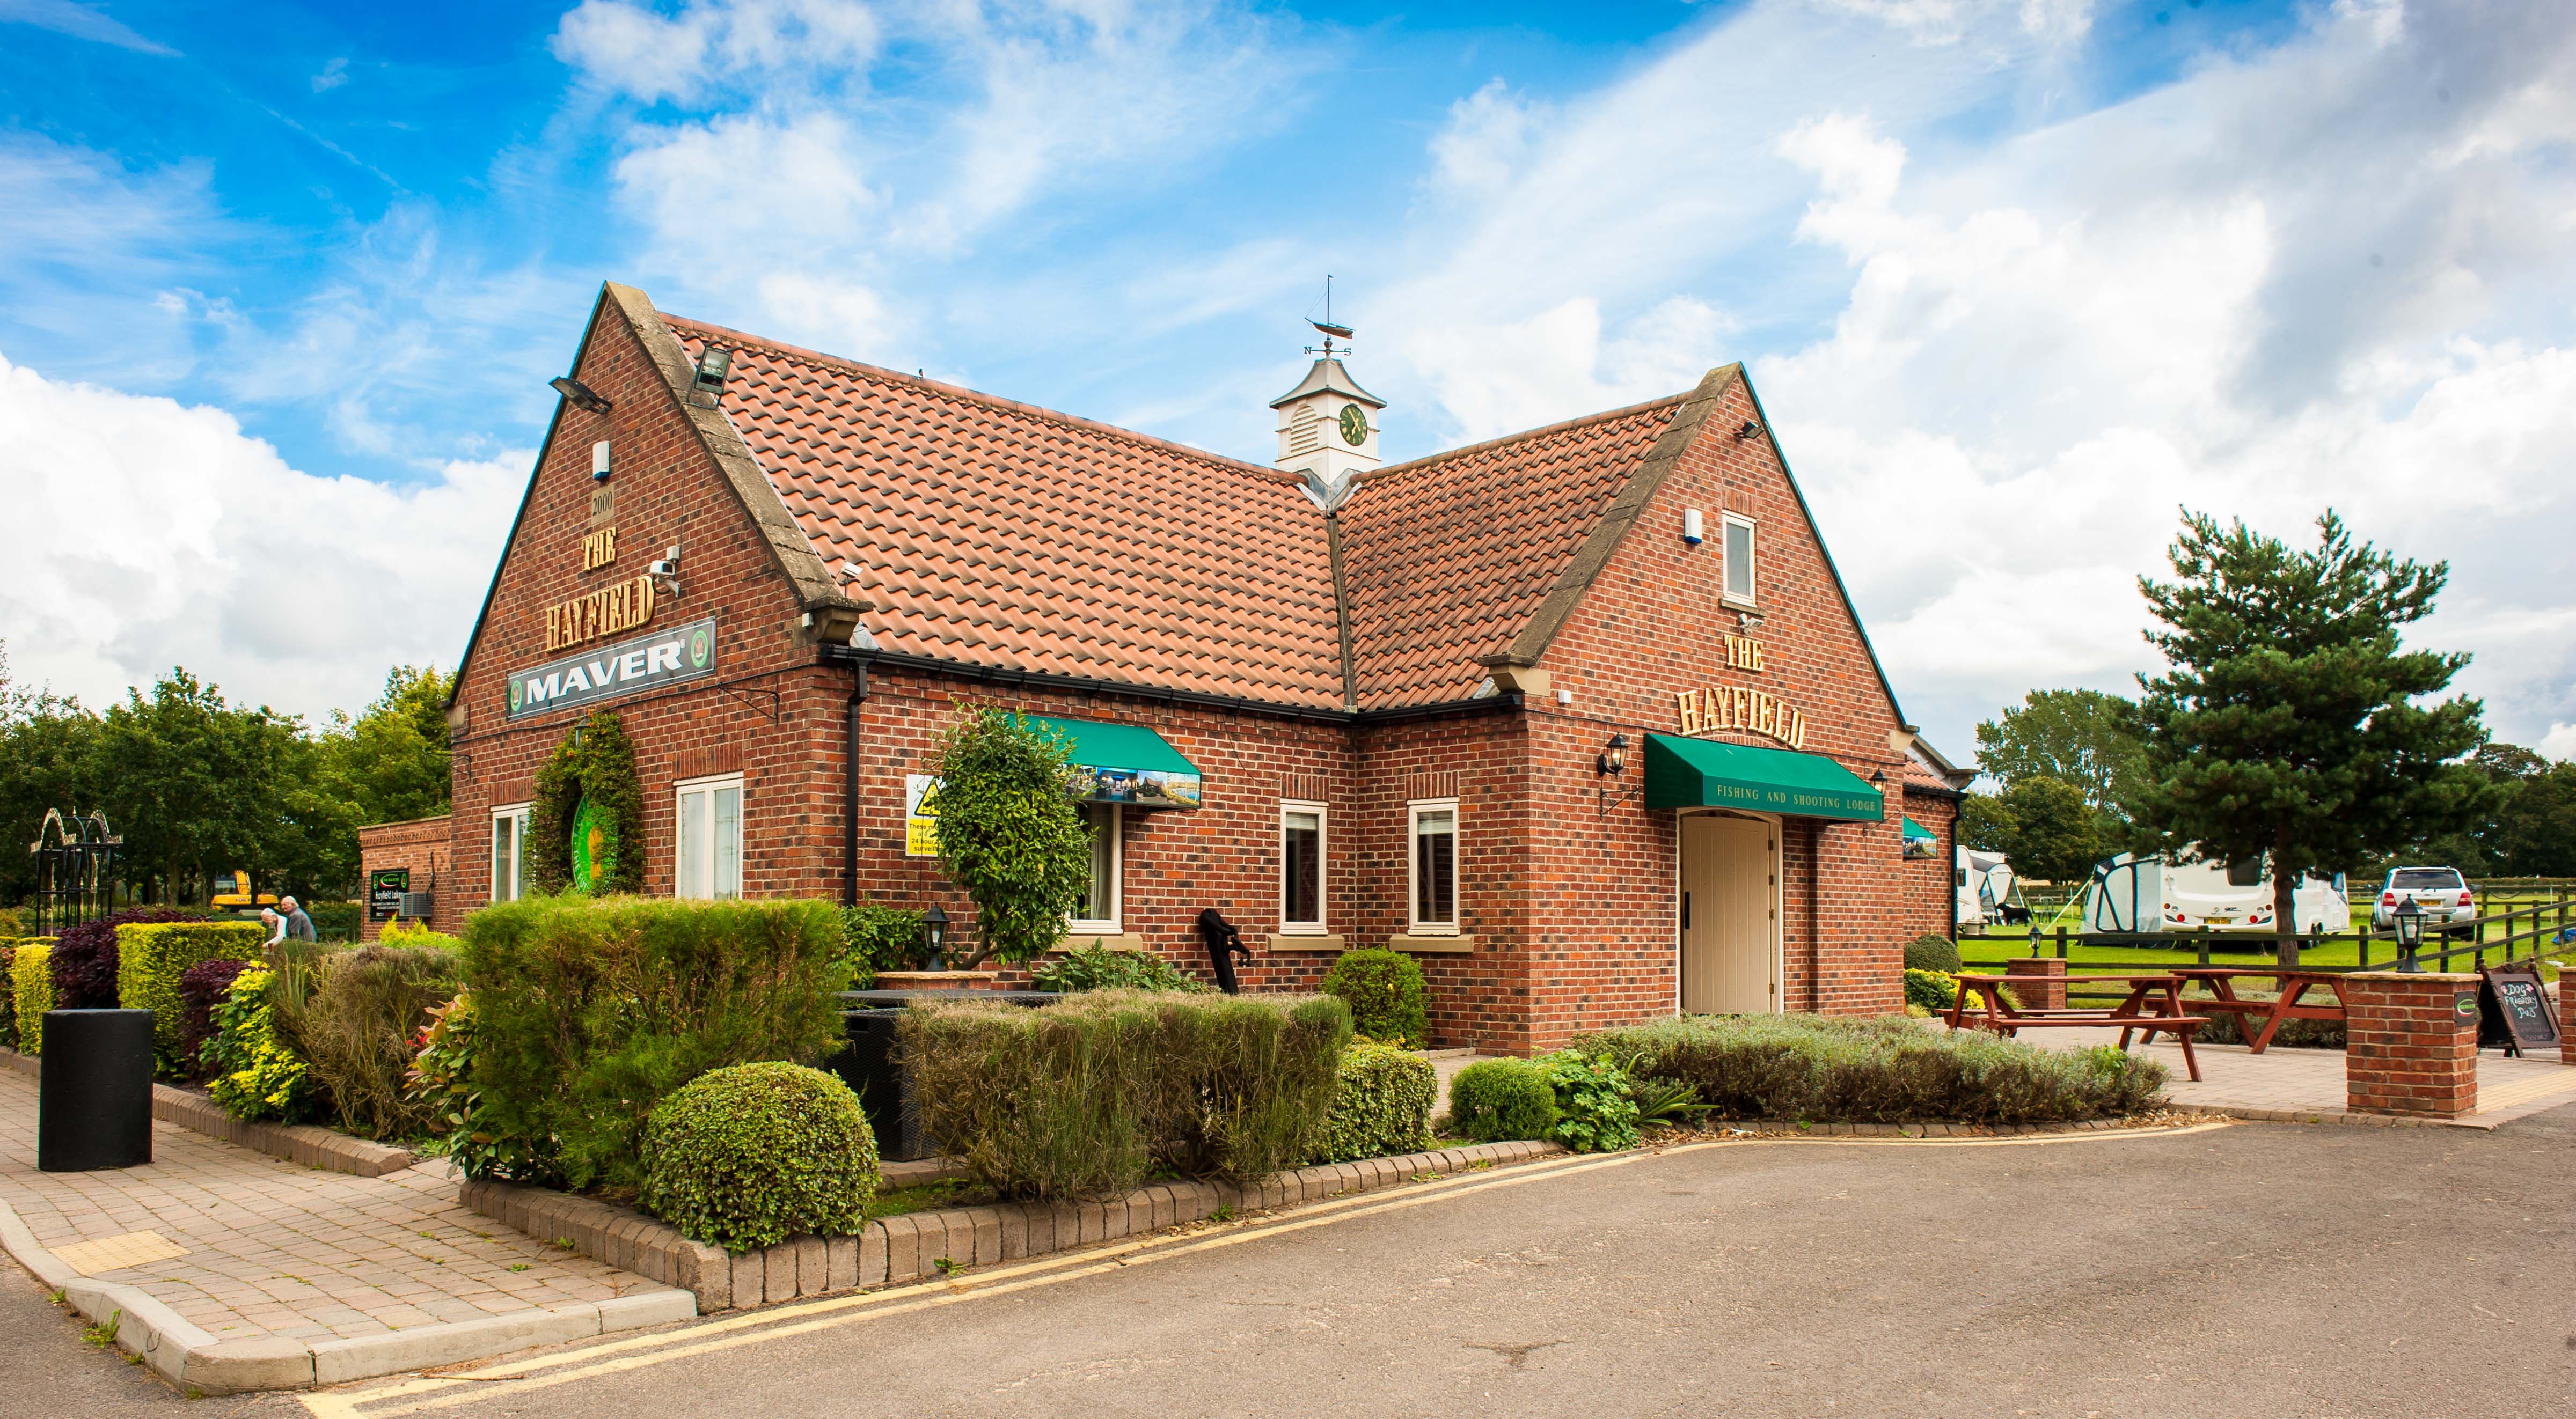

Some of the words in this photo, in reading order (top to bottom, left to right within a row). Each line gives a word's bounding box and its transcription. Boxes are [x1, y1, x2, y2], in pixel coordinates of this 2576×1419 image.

[1304, 347, 1312, 355] N
[592, 491, 613, 517] 2000
[581, 526, 617, 572] THE
[545, 575, 655, 653] HAYFIELD
[526, 641, 684, 704] MAVER
[1724, 634, 1764, 672] THE
[1677, 686, 1806, 750] HAYFIELD
[1717, 785, 1759, 800] FISHING
[1767, 791, 1787, 803] AND
[1794, 794, 1840, 808] SHOOTING
[1847, 799, 1876, 811] LODGE
